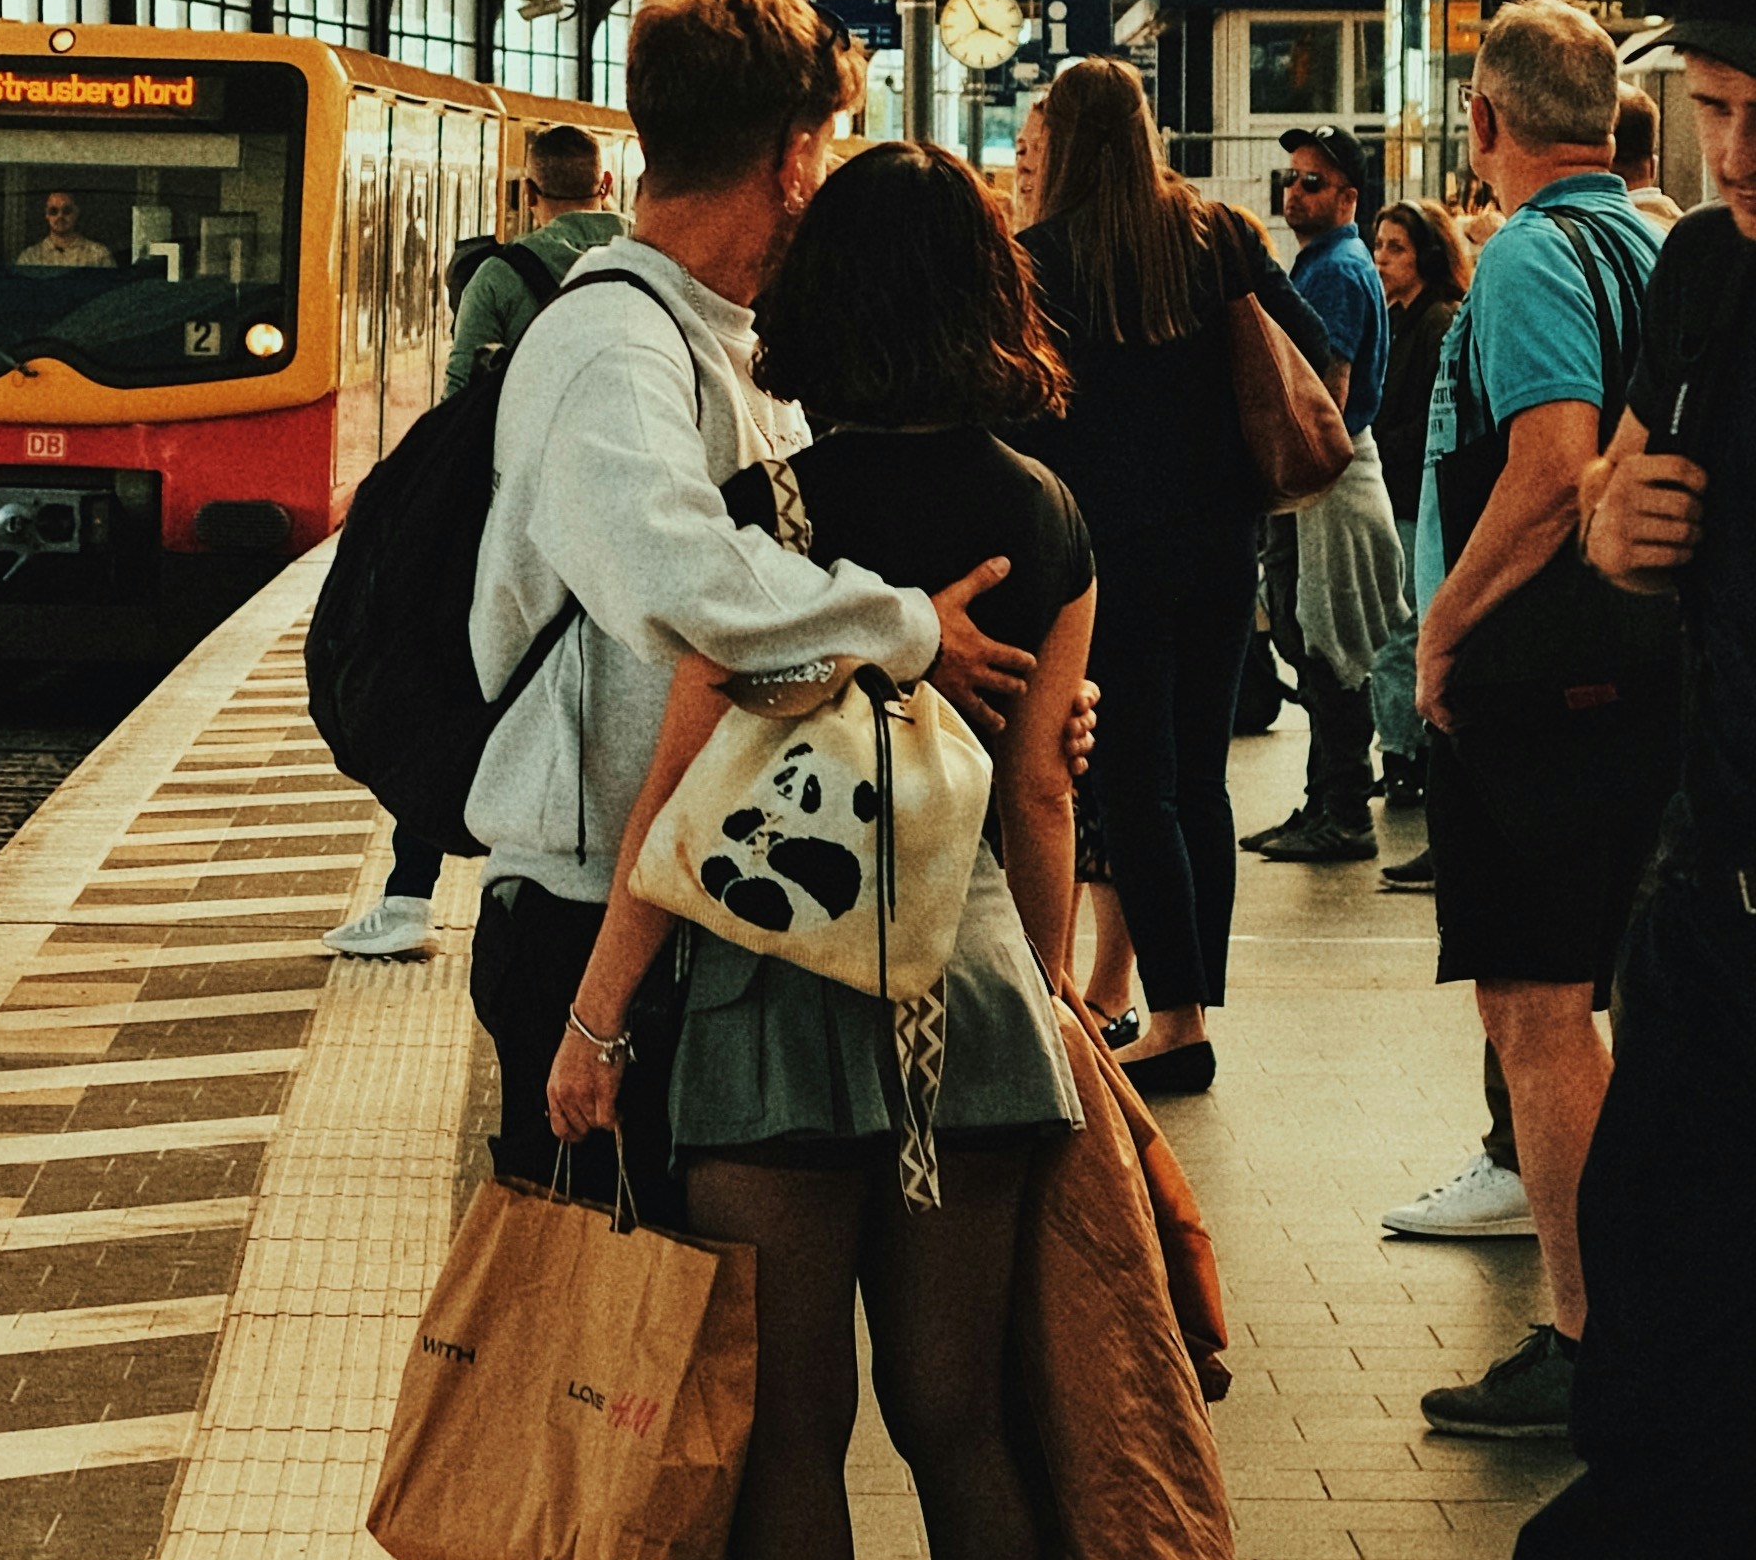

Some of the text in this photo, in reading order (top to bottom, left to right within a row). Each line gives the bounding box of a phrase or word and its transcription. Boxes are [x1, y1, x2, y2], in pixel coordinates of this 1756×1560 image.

[133, 75, 194, 106] Nord
[193, 321, 212, 353] 2
[29, 434, 62, 455] DB
[423, 1335, 476, 1365] WITH
